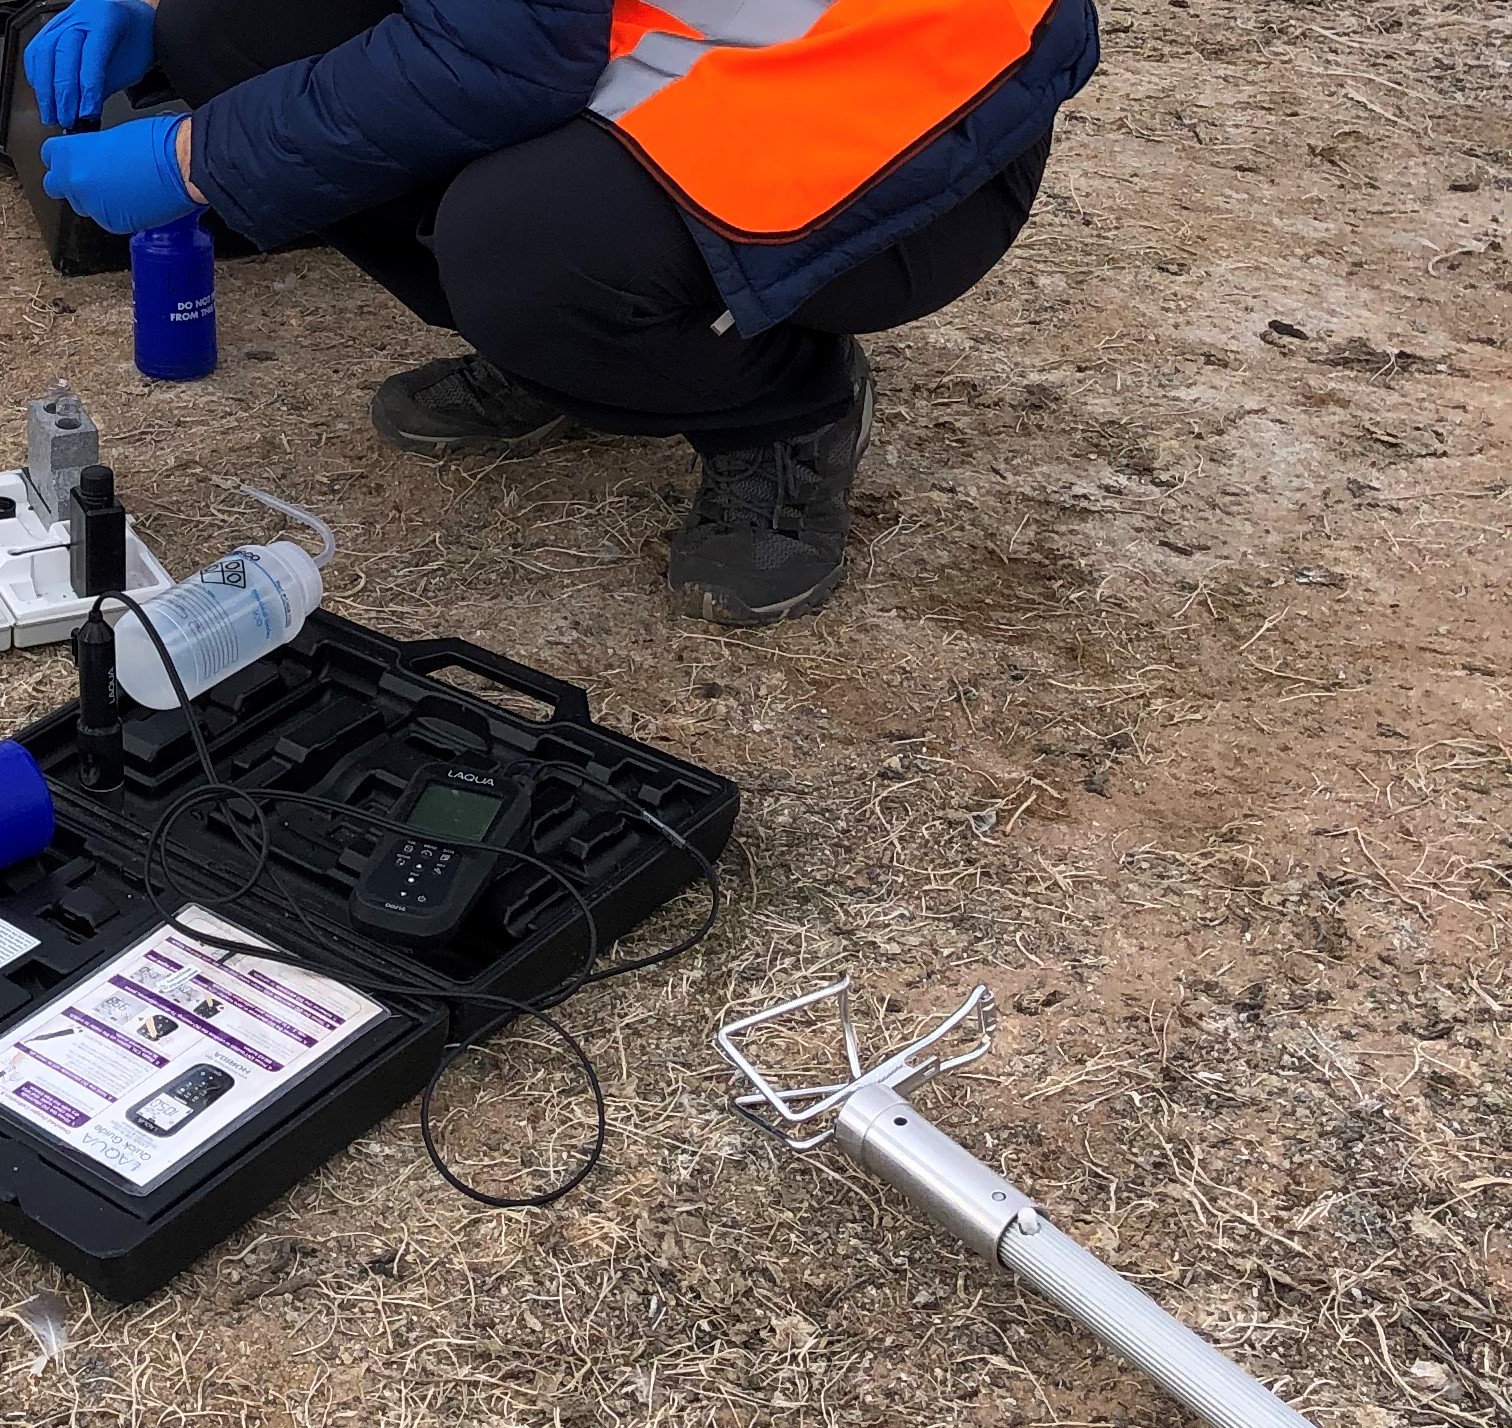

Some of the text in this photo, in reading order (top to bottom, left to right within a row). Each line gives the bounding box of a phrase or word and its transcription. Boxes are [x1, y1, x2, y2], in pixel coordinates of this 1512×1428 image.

[170, 312, 199, 322] FROM
[177, 301, 193, 311] DO
[107, 667, 115, 705] LAQUA
[448, 769, 495, 787] LAQUA
[211, 1050, 252, 1075] HORIBA
[89, 1123, 125, 1145] Guide
[76, 1131, 144, 1173] LAQUA
[119, 1140, 153, 1162] Quick
